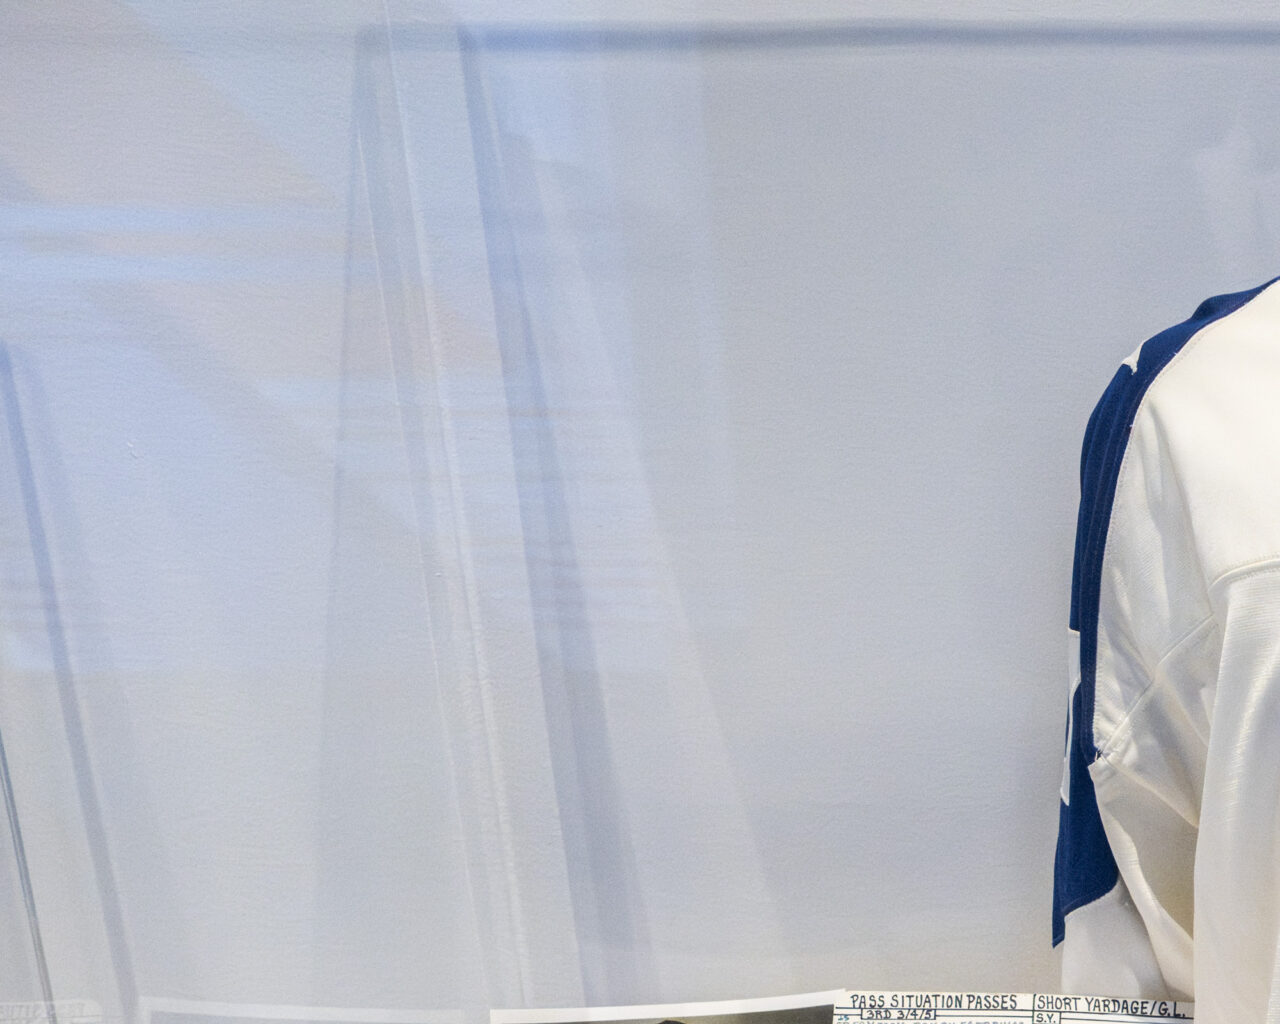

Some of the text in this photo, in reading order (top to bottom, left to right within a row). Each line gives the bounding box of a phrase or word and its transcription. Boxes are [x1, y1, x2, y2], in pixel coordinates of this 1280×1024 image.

[851, 995, 1017, 1009] PASS SITUATION PASSES
[1037, 996, 1080, 1010] SHORT
[867, 1011, 932, 1019] 3RD 3/4/5
[1036, 1014, 1056, 1023] S.Y.
